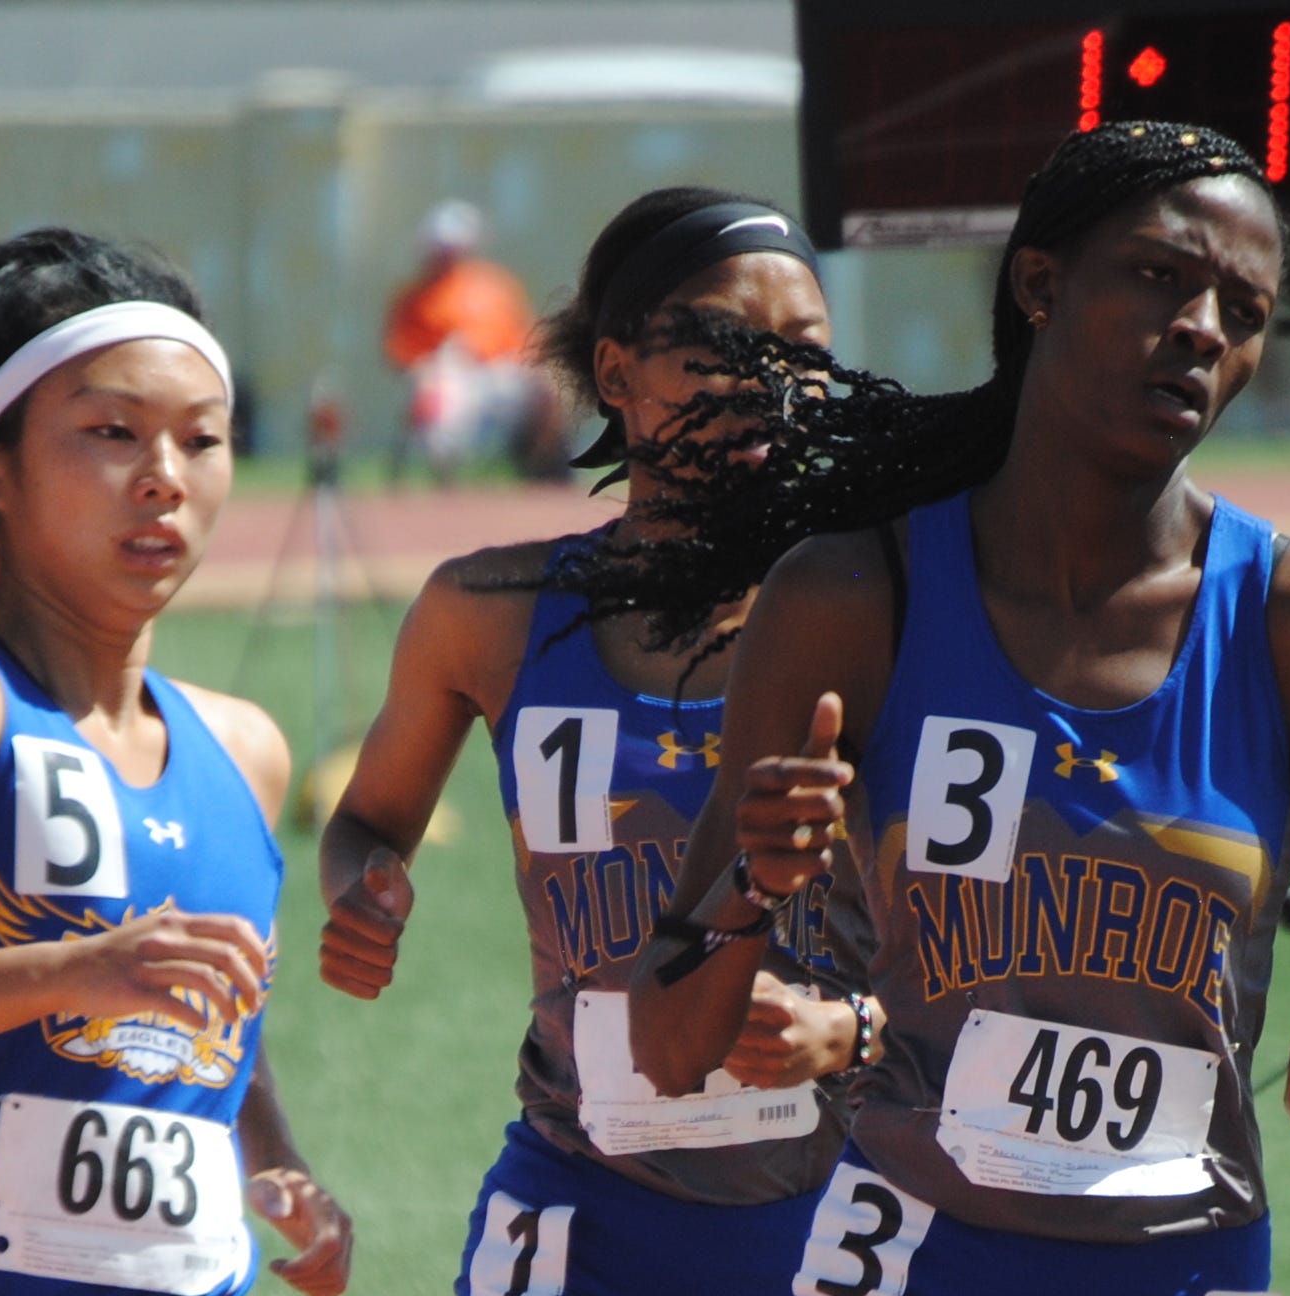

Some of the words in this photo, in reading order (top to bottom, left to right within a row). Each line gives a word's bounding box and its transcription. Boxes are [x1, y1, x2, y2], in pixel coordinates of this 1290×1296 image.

[42, 751, 101, 887] 5
[538, 717, 584, 844] 1
[925, 728, 1005, 866] 3
[907, 852, 1239, 1033] MONROE
[1007, 1028, 1163, 1152] 469
[57, 1109, 198, 1227] 663
